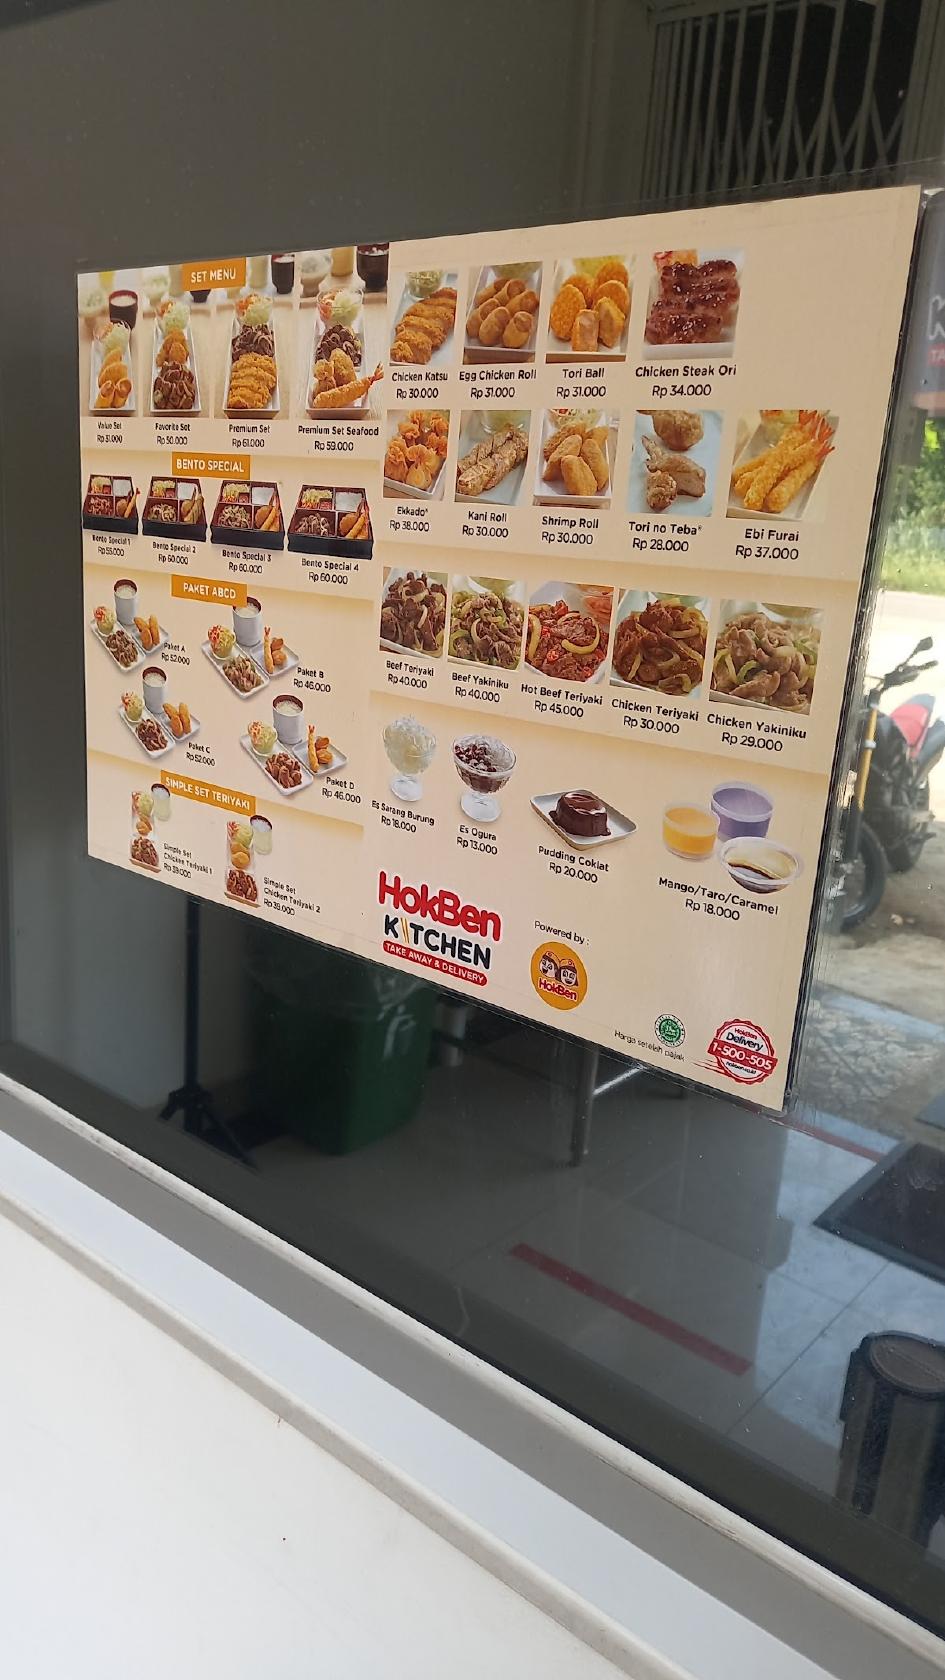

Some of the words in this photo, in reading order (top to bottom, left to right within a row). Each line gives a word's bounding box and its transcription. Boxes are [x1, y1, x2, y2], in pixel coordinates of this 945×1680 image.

[191, 271, 207, 283] SET
[210, 268, 236, 280] MENU
[392, 372, 422, 382] Chicken
[425, 372, 448, 381] Katsu
[459, 371, 476, 382] Egg
[479, 370, 515, 380] Chicken
[518, 369, 537, 380] Roll
[562, 368, 582, 378] Tori
[585, 368, 605, 378] Ball
[635, 366, 679, 377] Chicken
[683, 365, 714, 377] Steak
[718, 364, 737, 376] Ori
[396, 388, 407, 399] Rp
[409, 388, 439, 398] 30.000
[471, 388, 483, 399] Rp
[485, 387, 515, 398] 31.000
[556, 386, 570, 398] Rp
[572, 386, 606, 397] 31.000
[652, 385, 667, 398] Rp
[670, 384, 712, 397] 34.000
[155, 423, 179, 431] Favorite
[180, 423, 191, 431] Set
[229, 424, 257, 433] Premium
[259, 424, 270, 434] Set
[298, 426, 329, 435] Premium
[332, 426, 344, 435] Set
[346, 427, 379, 436] Seafood
[157, 436, 165, 446] Rp
[166, 436, 188, 445] 50.000
[232, 438, 241, 448] Rp
[314, 441, 325, 451] Rp
[326, 441, 354, 451] 59.000
[177, 459, 205, 470] BENTO
[208, 461, 244, 472] SPECIAL
[468, 511, 488, 521] Kani
[490, 512, 507, 522] Roll
[542, 516, 576, 529] Shrimp
[579, 518, 599, 529] Roll
[389, 520, 400, 531] Rp
[402, 521, 430, 532] 38.000
[462, 525, 474, 536] Rp
[476, 526, 509, 538] 30.000
[629, 521, 650, 533] Tori
[654, 524, 666, 533] no
[541, 532, 555, 544] Rp
[557, 533, 593, 545] 30.000
[745, 529, 764, 539] Ebi
[767, 530, 799, 542] Furai
[632, 538, 647, 551] Rp
[650, 539, 689, 552] 28.000
[222, 549, 240, 559] Bento
[242, 551, 265, 562] Special
[735, 545, 752, 559] Rp
[754, 546, 799, 560] 37.000
[228, 562, 237, 572] Rp
[302, 558, 322, 568] Bento
[324, 560, 352, 571] Special
[308, 572, 318, 582] Rp
[183, 582, 209, 596] PAKET
[212, 588, 236, 599] ABCD
[297, 667, 317, 677] Paket
[386, 660, 403, 671] Beef
[404, 663, 434, 677] Teriyaki
[293, 678, 303, 688] Rp
[387, 673, 399, 684] Rp
[399, 676, 427, 689] 40.000
[452, 672, 471, 683] Beef
[473, 675, 509, 690] Yakiniku
[455, 686, 467, 697] Rp
[468, 689, 500, 703] 40.000
[521, 683, 538, 695] Hot
[540, 686, 562, 699] Beef
[564, 690, 603, 706] Teriyaki
[534, 700, 547, 712] Rp
[549, 702, 584, 718] 45.000
[611, 698, 652, 713] Chicken
[655, 705, 699, 722] Teriyaki
[623, 715, 638, 728] Rp
[640, 718, 679, 734] 30.000
[707, 713, 752, 729] Chicken
[756, 721, 807, 739] Yakiniku
[722, 731, 738, 745] Rp
[740, 735, 783, 752] 29.000
[326, 777, 347, 789] Paket
[165, 777, 193, 793] SIMPLE
[195, 786, 210, 798] SET
[212, 790, 250, 810] TERIYAKI
[322, 787, 332, 798] Rp
[334, 790, 361, 804] 46.000
[371, 800, 380, 810] Es
[381, 802, 405, 818] Sarang
[407, 810, 435, 826] Burung
[381, 815, 391, 827] Rp
[459, 825, 469, 834] Es
[471, 827, 497, 842] Ogura
[456, 837, 468, 849] Rp
[469, 839, 498, 855] 13.000
[538, 846, 576, 864] Pudding
[578, 856, 609, 873] Coklat
[549, 861, 562, 875] Rp
[563, 865, 598, 883] 20.000
[659, 877, 778, 915] Mango/Taro/Caramel
[379, 871, 500, 941] HokBen
[685, 898, 700, 911] Rp
[703, 902, 740, 921] 18.000
[534, 920, 572, 939] Powered
[385, 943, 406, 956] TAKE
[408, 950, 433, 966] AWAY
[434, 960, 440, 968] &
[442, 963, 485, 984] DELIVERY
[539, 978, 577, 1000] HokBen
[614, 1030, 636, 1044] Harga
[726, 1032, 763, 1051] Delivery
[712, 1042, 773, 1070] 1-500-505
